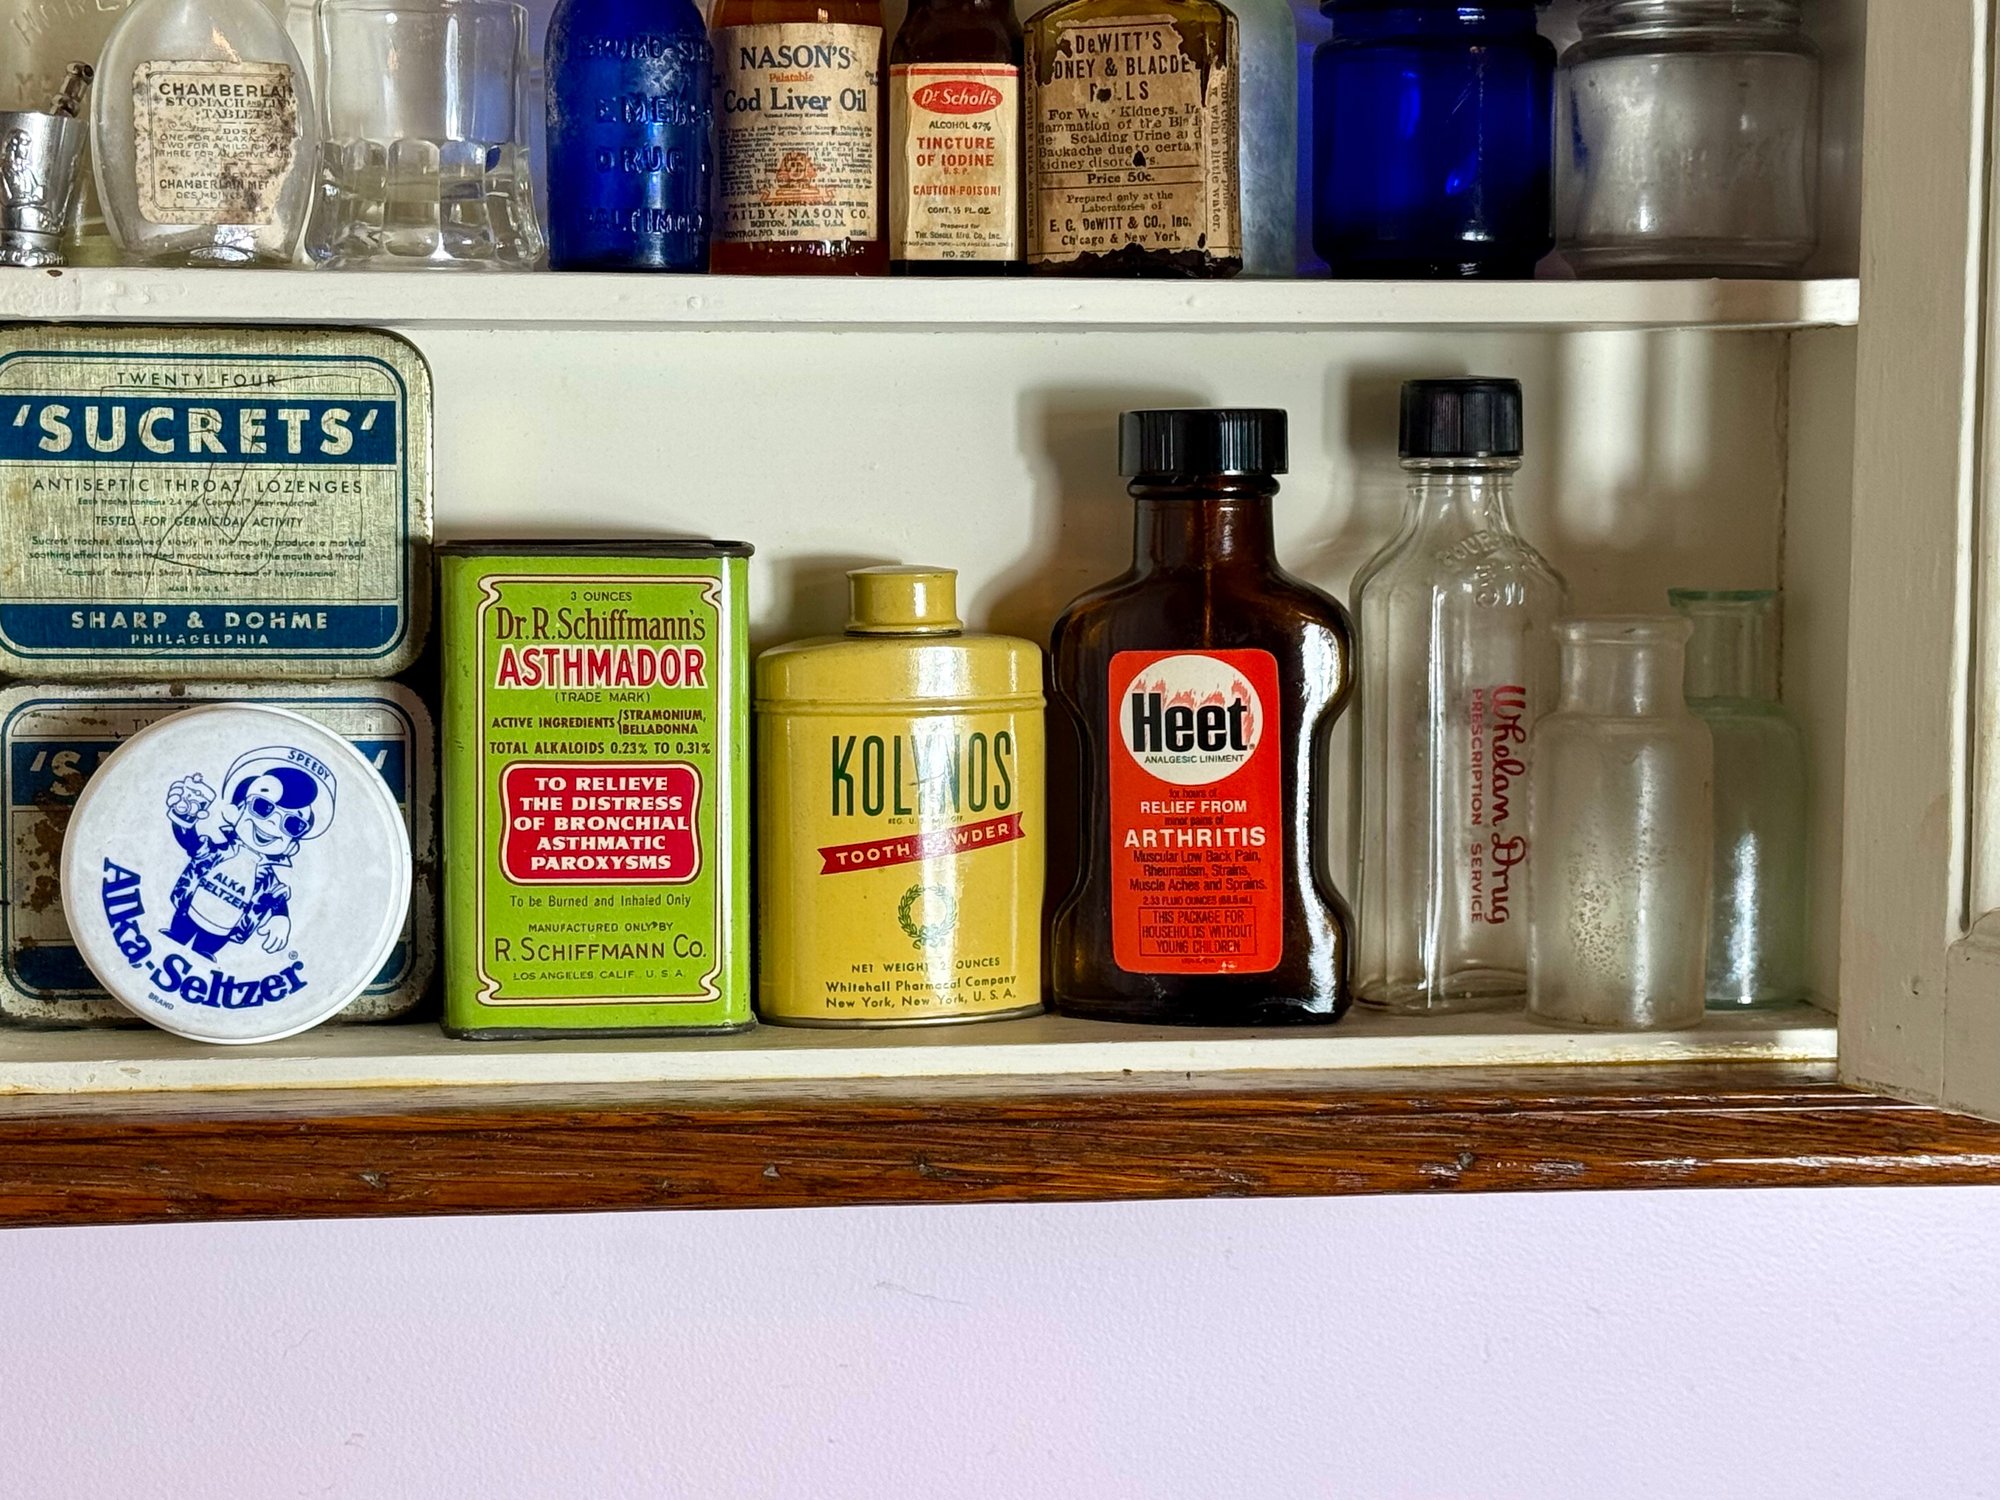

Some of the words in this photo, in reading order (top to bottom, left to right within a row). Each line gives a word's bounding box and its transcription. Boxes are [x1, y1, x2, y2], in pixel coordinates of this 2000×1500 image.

[1075, 30, 1162, 54] DeWITT'S
[739, 44, 851, 70] NASON'S
[1053, 58, 1096, 80] DNEY
[1104, 57, 1118, 77] &
[768, 71, 815, 83] Palatable
[723, 87, 762, 114] Cod
[770, 86, 832, 112] Liver
[839, 87, 867, 113] Oil
[940, 88, 998, 106] Scholl's
[1048, 109, 1073, 121] For
[928, 120, 971, 130] ALCOHOL
[916, 136, 996, 150] TINCTURE
[1070, 132, 1129, 147] Scalding
[1133, 130, 1171, 141] Urine
[916, 153, 936, 167] OF
[941, 153, 996, 167] IODINE
[1039, 157, 1085, 171] kidney
[1087, 172, 1121, 185] Price
[1127, 171, 1156, 183] 50c.
[1066, 191, 1112, 204] Prepared
[1116, 192, 1140, 205] only
[1156, 191, 1174, 201] the
[1151, 201, 1163, 210] of
[850, 208, 871, 220] CO.
[1049, 219, 1060, 233] E.
[1082, 216, 1123, 231] DeWITT
[1127, 216, 1138, 229] &
[1109, 233, 1119, 244] &
[1124, 232, 1148, 243] New
[1154, 230, 1181, 243] York
[960, 250, 977, 259] 292
[117, 371, 277, 388] TWENTY-FOUR
[32, 478, 150, 493] ANTISEPTIC
[164, 479, 241, 494] THROAT
[257, 479, 363, 495] LOZENGES
[95, 515, 136, 527] TESTED
[143, 515, 168, 527] FOR
[174, 515, 246, 528] GERMICIDAL
[252, 516, 304, 528] ACTIVITY
[570, 591, 577, 601] 3
[583, 591, 633, 602] OUNCES
[71, 610, 168, 630] SHARP
[186, 610, 205, 629] &
[224, 611, 328, 630] DOHME
[131, 633, 270, 646] PHILADELPHIA
[496, 645, 708, 689] ASTHMADOR
[554, 691, 603, 704] (TRADE
[608, 691, 651, 704] MARK)
[492, 717, 533, 729] ACTIVE
[538, 716, 616, 729] INGREDIENTS
[621, 708, 707, 723] STRAMONIUM,
[1131, 691, 1249, 753] Heet
[621, 722, 699, 736] BELLADONNA
[489, 741, 529, 755] TOTAL
[534, 741, 605, 755] ALKALOIDS
[609, 741, 648, 755] 0.23%
[653, 741, 671, 755] TO
[675, 741, 711, 755] 0.31%
[1144, 755, 1198, 765] ANALGESIC
[1199, 754, 1245, 764] LINIMENT
[1470, 687, 1483, 827] PRESCRIPTION
[1490, 684, 1527, 828] Whelan
[287, 749, 331, 781] SPEEDY
[534, 776, 568, 791] TO
[575, 776, 669, 792] RELIEVE
[519, 796, 563, 812] THE
[571, 796, 683, 812] DISTRESS
[1140, 800, 1196, 814] RELIEF
[1200, 799, 1248, 814] FROM
[513, 816, 546, 832] OF
[553, 816, 690, 832] BRONCHIAL
[536, 835, 667, 851] ASTHMATIC
[1123, 826, 1267, 849] ARTHRITIS
[835, 842, 911, 866] TOOTH
[1133, 850, 1179, 863] Muscular
[1180, 850, 1203, 863] Low
[1205, 850, 1232, 862] Back
[1234, 850, 1262, 864] Pain,
[530, 854, 672, 871] PAROXYSMS
[212, 871, 247, 897] ALKA
[1129, 878, 1166, 892] Muscle
[1168, 878, 1200, 892] Aches
[1203, 878, 1223, 892] and
[1470, 842, 1483, 924] SERVICE
[1484, 832, 1527, 926] Drug
[510, 895, 524, 908] To
[529, 895, 543, 908] be
[548, 895, 588, 908] Burned
[593, 895, 614, 908] and
[620, 894, 662, 908] Inhaled
[666, 893, 692, 908] Only
[1152, 910, 1175, 924] THIS
[1177, 910, 1221, 924] PACKAGE
[1224, 909, 1245, 923] FOR
[528, 922, 619, 933] MANUFACTURED
[624, 922, 652, 933] ONLY
[659, 921, 674, 932] BY
[1209, 924, 1254, 938] WITHOUT
[1156, 940, 1189, 954] YOUNG
[1192, 939, 1241, 954] CHILDREN
[851, 963, 874, 974] NET
[955, 956, 1001, 970] OUNCES
[513, 970, 537, 981] LOS
[825, 981, 891, 993] Whitehall
[896, 978, 961, 993] Pharmacal
[965, 974, 1017, 988] Company
[148, 990, 176, 1012] BRAND
[825, 997, 856, 1009] New
[861, 996, 895, 1009] York,
[901, 995, 930, 1007] New
[936, 993, 968, 1006] York,
